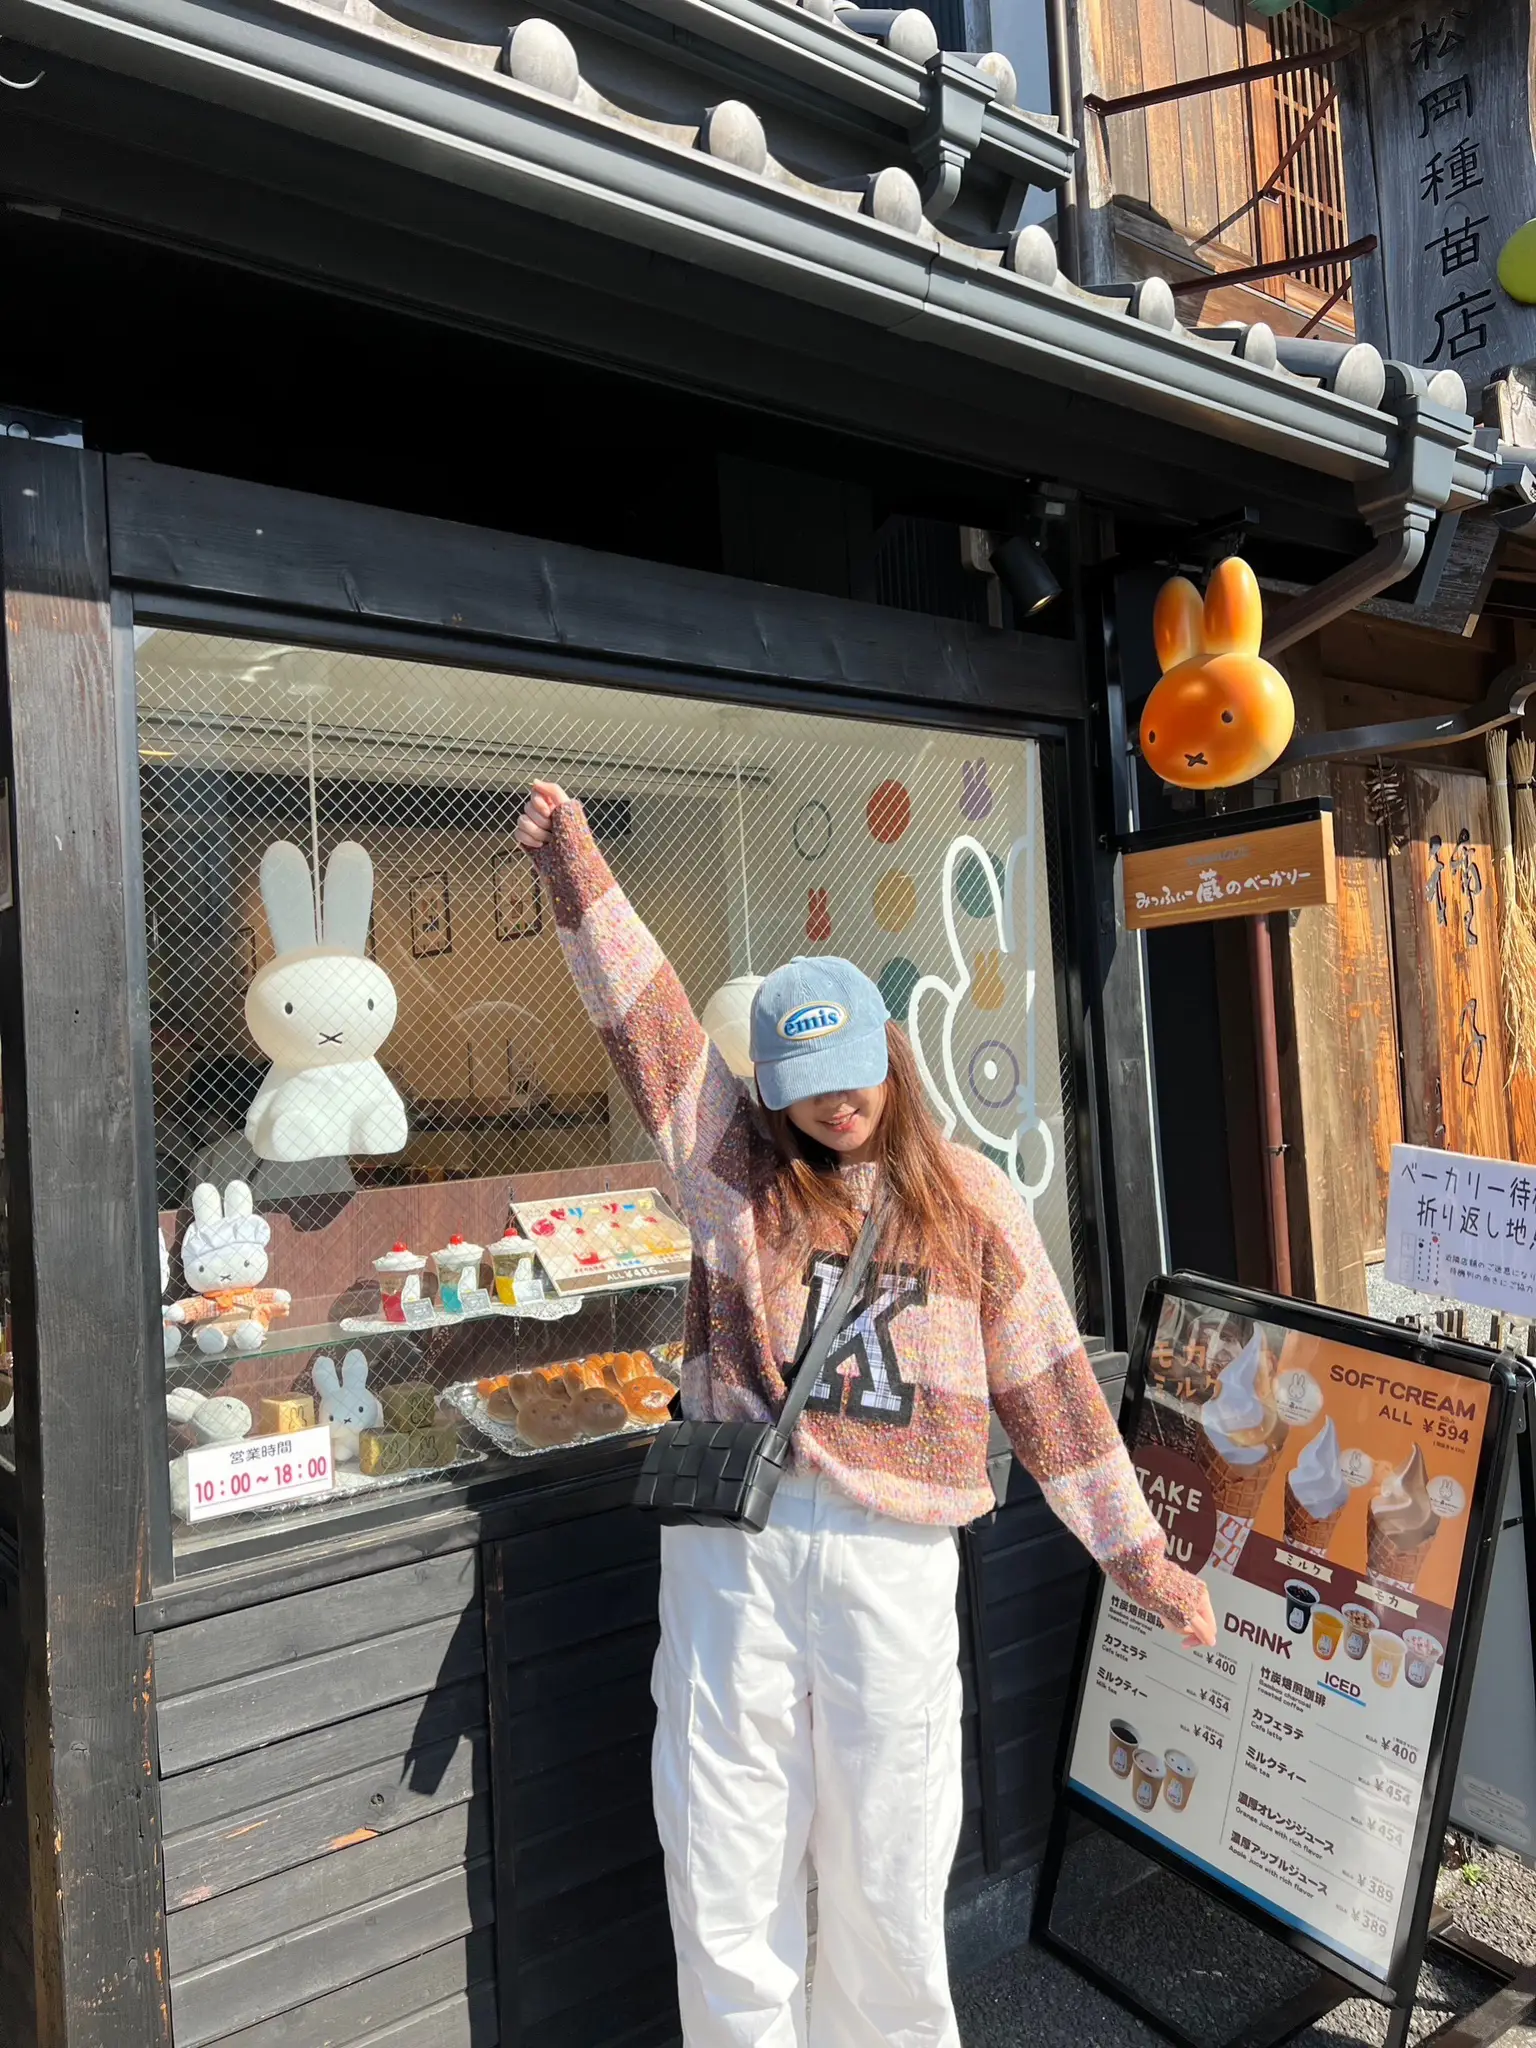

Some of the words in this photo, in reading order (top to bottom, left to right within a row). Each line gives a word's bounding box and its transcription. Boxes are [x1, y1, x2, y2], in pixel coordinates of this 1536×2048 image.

[1410, 8, 1496, 364] 松岡種苗店
[784, 1010, 839, 1036] emis
[1330, 1364, 1476, 1421] SOFTCREAM
[1379, 1405, 1412, 1426] ALL
[1423, 1418, 1469, 1444] ¥594
[229, 1440, 292, 1464] 営業時間
[1136, 1466, 1202, 1512] TAKE
[1147, 1499, 1180, 1529] UT
[1165, 1535, 1193, 1562] NU
[1286, 1554, 1321, 1575] ミルク
[1375, 1589, 1399, 1608] モカ
[1104, 1633, 1147, 1661] カフェラテ
[1224, 1612, 1293, 1659] DRINK
[1205, 1652, 1236, 1676] ¥400
[1097, 1666, 1148, 1698] ミルクティー
[1324, 1671, 1361, 1698] ICED
[1199, 1688, 1229, 1713] ¥454
[1193, 1724, 1223, 1750] ¥454
[1252, 1708, 1304, 1740] カフェラテ
[1381, 1737, 1417, 1764] ¥400
[1246, 1746, 1307, 1783] ミルクティー
